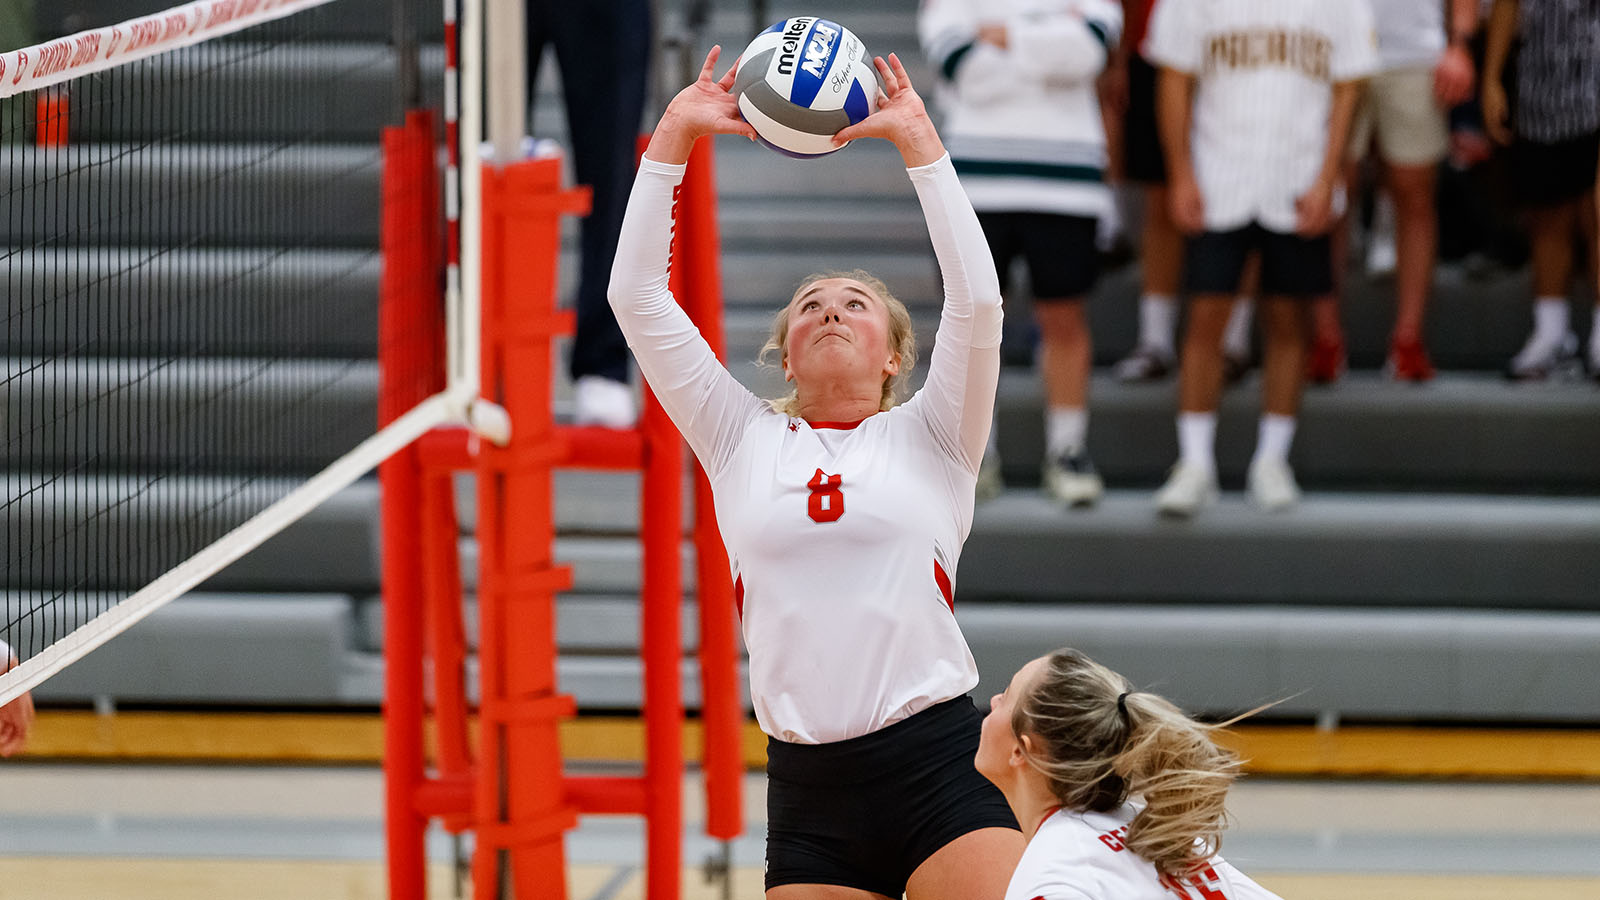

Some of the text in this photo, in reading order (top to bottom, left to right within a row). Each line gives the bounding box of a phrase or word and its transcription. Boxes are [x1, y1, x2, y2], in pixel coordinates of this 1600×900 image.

[32, 41, 72, 79] CENTRAL
[70, 33, 101, 68] DUTCH
[777, 18, 812, 75] molten
[801, 23, 838, 79] NCAA
[831, 62, 852, 94] Super
[806, 467, 845, 524] 8
